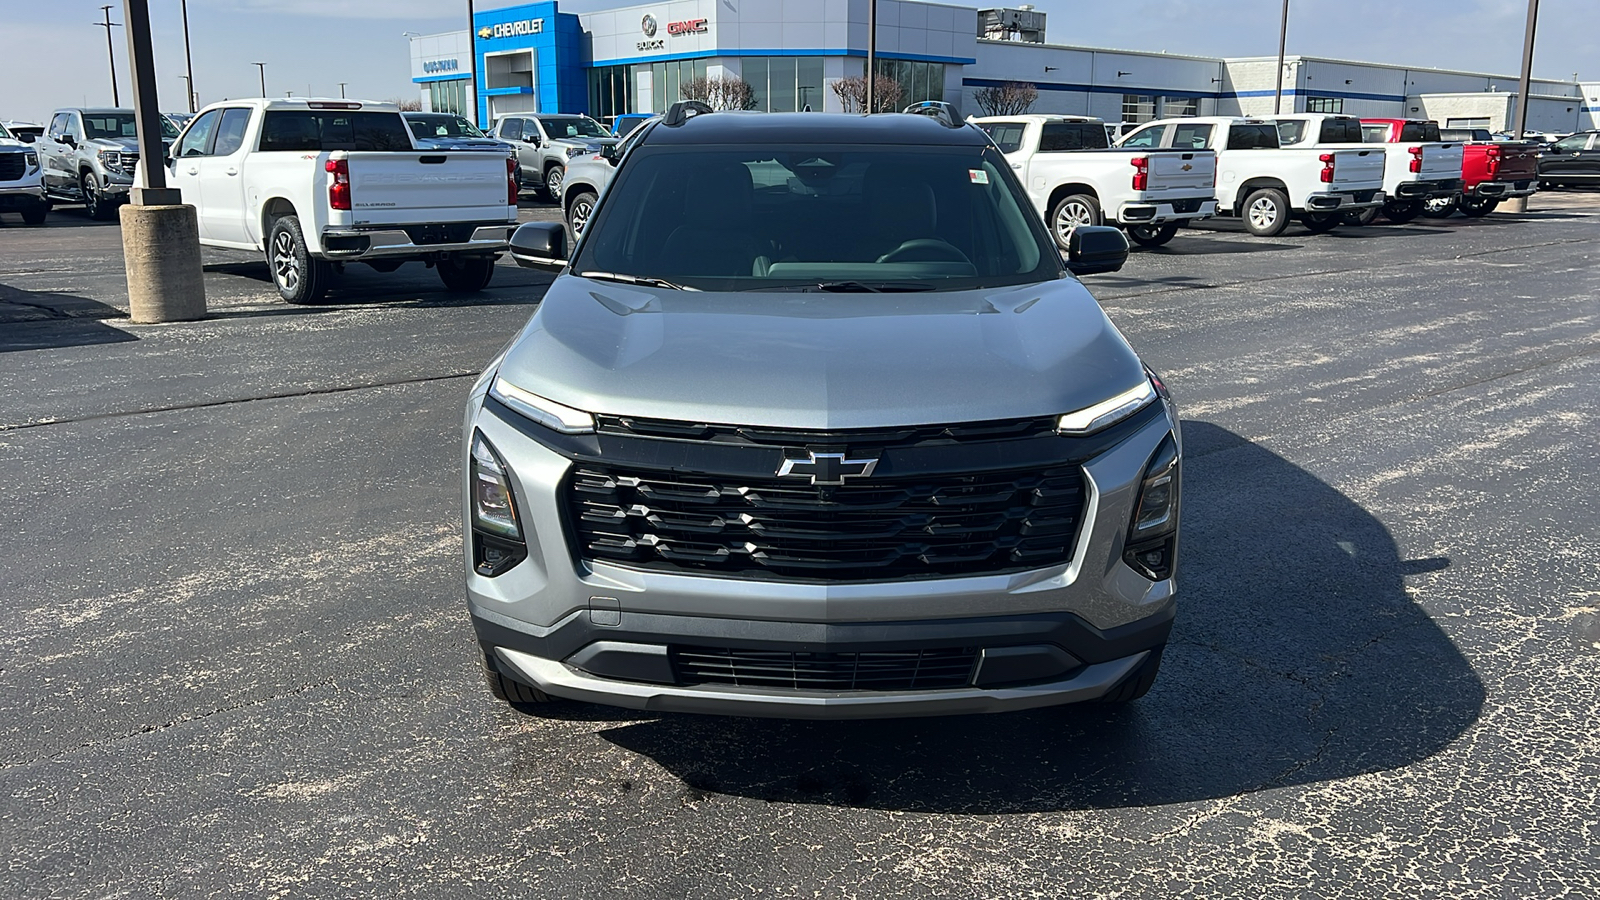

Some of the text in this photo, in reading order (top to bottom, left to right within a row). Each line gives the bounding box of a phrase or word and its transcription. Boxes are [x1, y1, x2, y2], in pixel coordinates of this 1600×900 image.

[494, 18, 543, 38] CHEVROLET
[667, 20, 707, 34] GMC
[637, 40, 664, 50] BUICK
